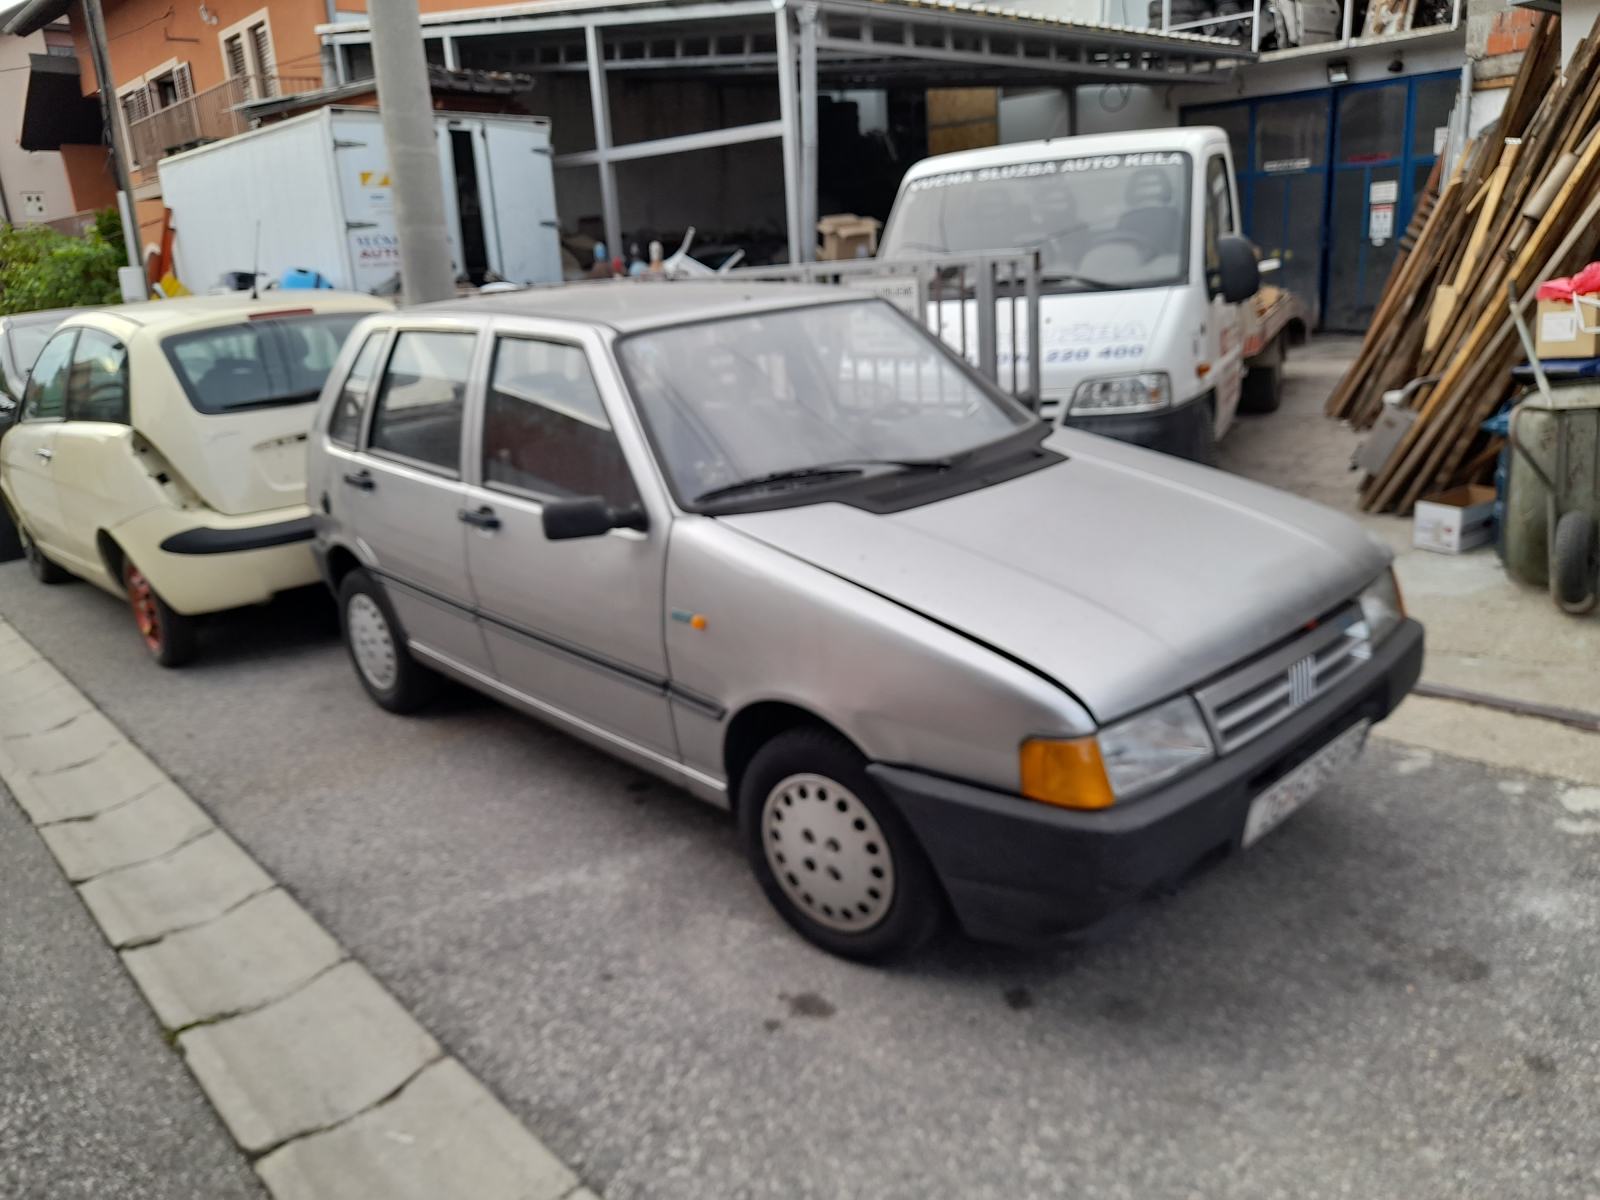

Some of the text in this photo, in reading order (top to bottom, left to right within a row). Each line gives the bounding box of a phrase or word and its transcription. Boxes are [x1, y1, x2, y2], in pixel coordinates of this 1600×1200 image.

[1060, 155, 1120, 172] AUTO
[1124, 152, 1184, 167] KELA
[1099, 344, 1145, 360] 400
